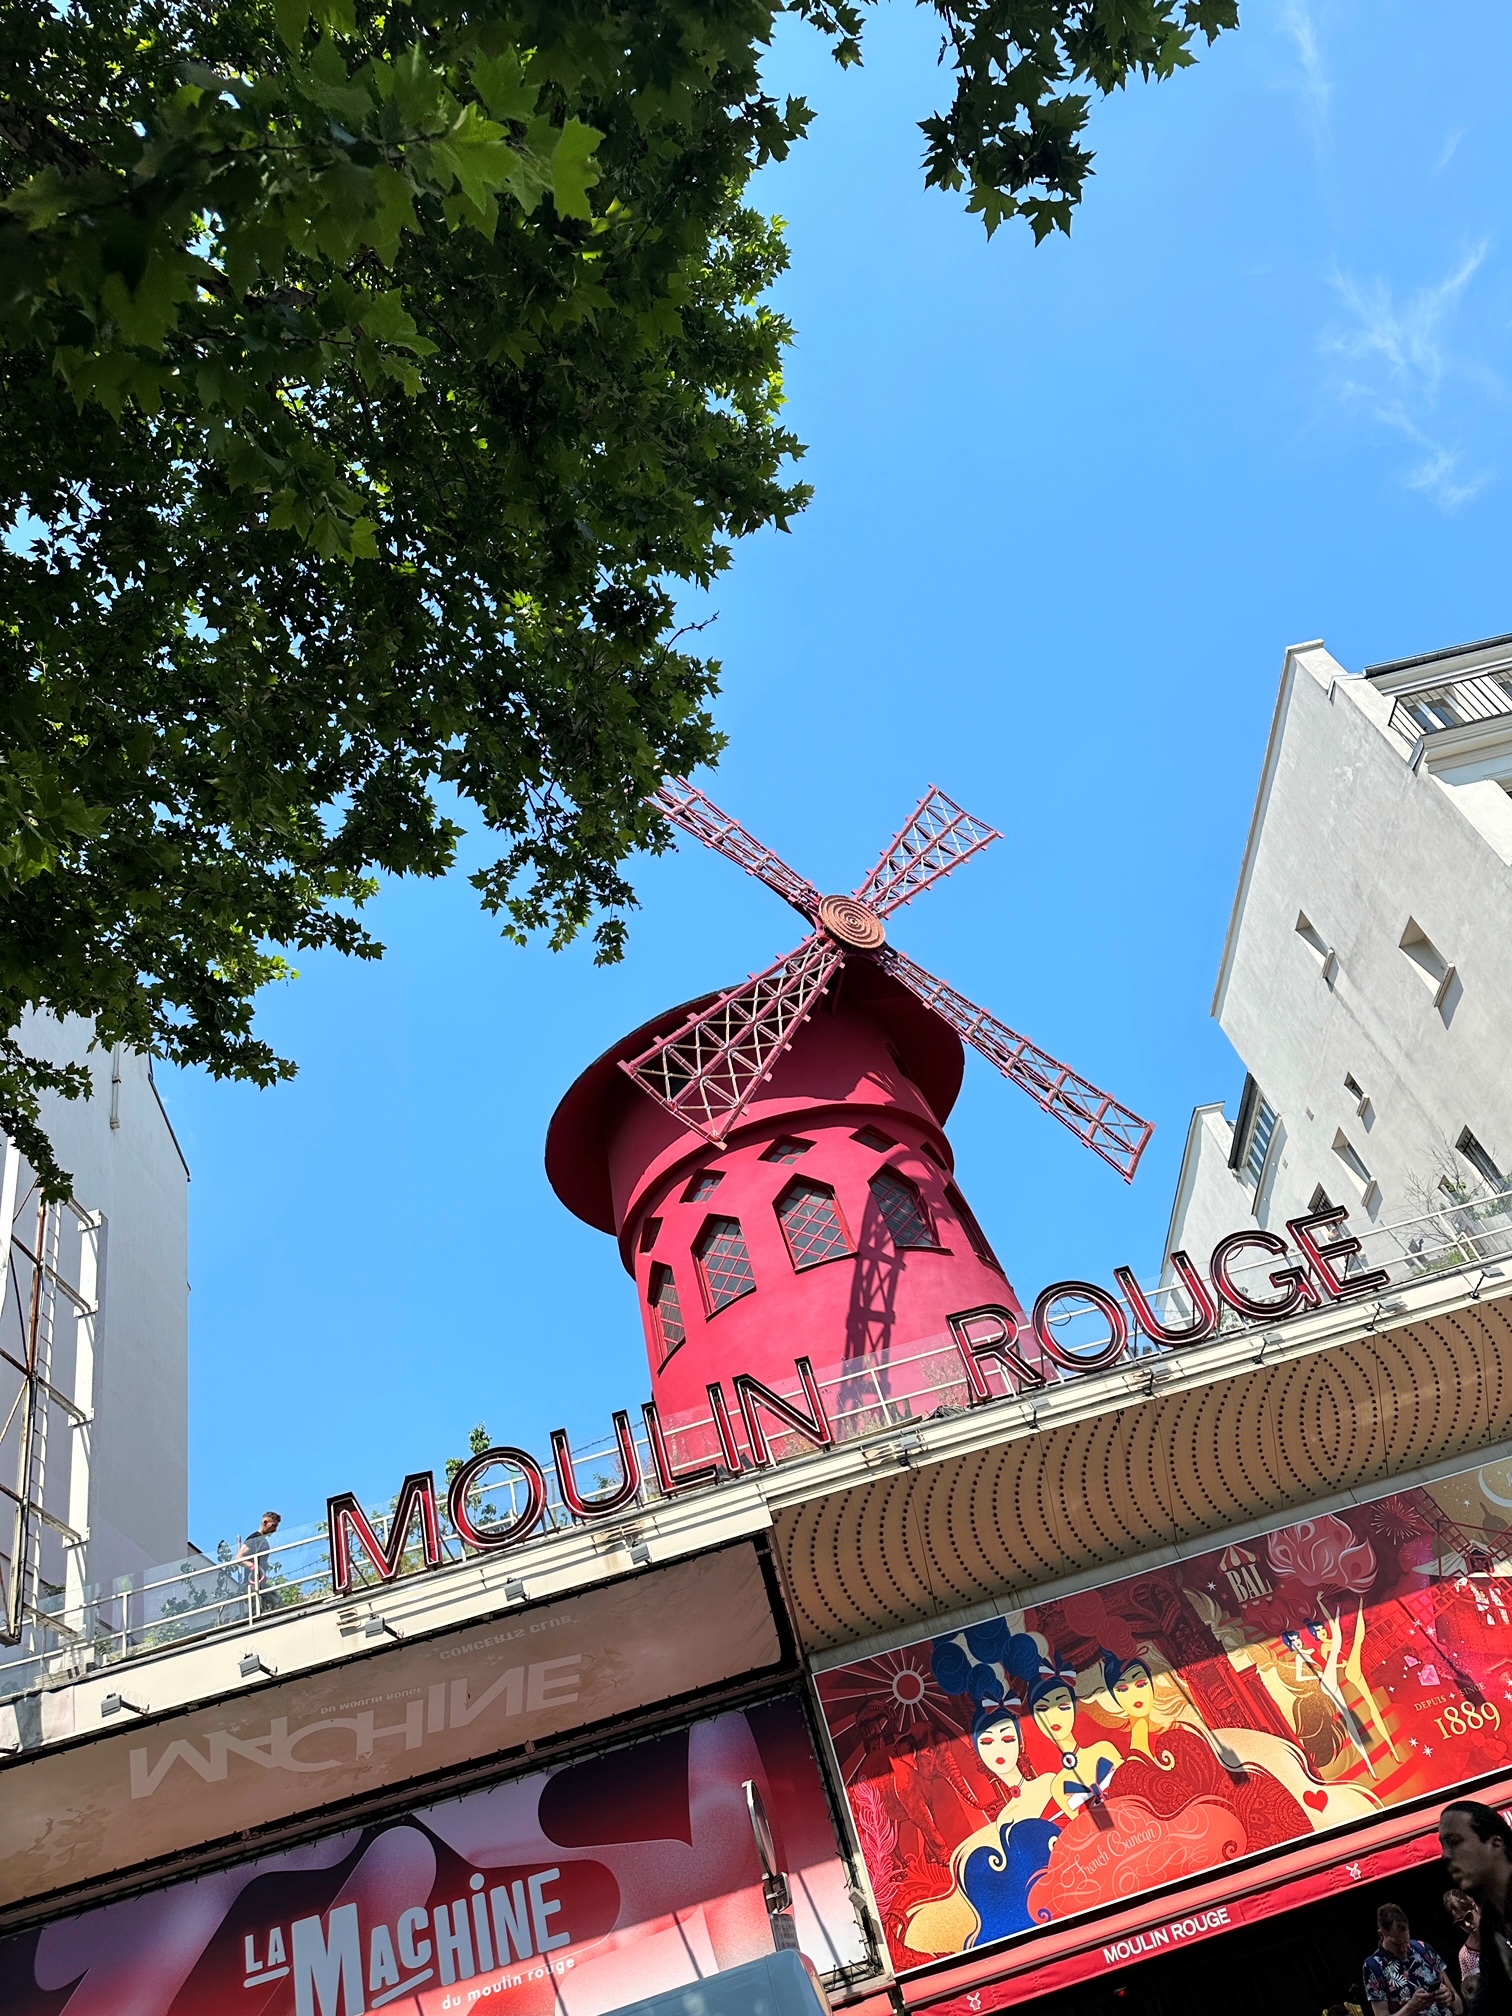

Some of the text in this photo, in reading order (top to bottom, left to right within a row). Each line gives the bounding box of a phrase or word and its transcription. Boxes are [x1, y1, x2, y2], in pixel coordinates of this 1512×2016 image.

[327, 1205, 1391, 1594] MOULIN ROUGE
[1224, 1563, 1274, 1604] BAL
[1413, 1682, 1487, 1712] DEPUIS SINCE
[1433, 1701, 1501, 1741] 1889
[1060, 1820, 1162, 1890] French Cancan
[244, 1926, 287, 1974] LA
[1102, 1907, 1231, 1964] MOULIN ROUGE
[442, 1957, 575, 2010] du moulin rouge
